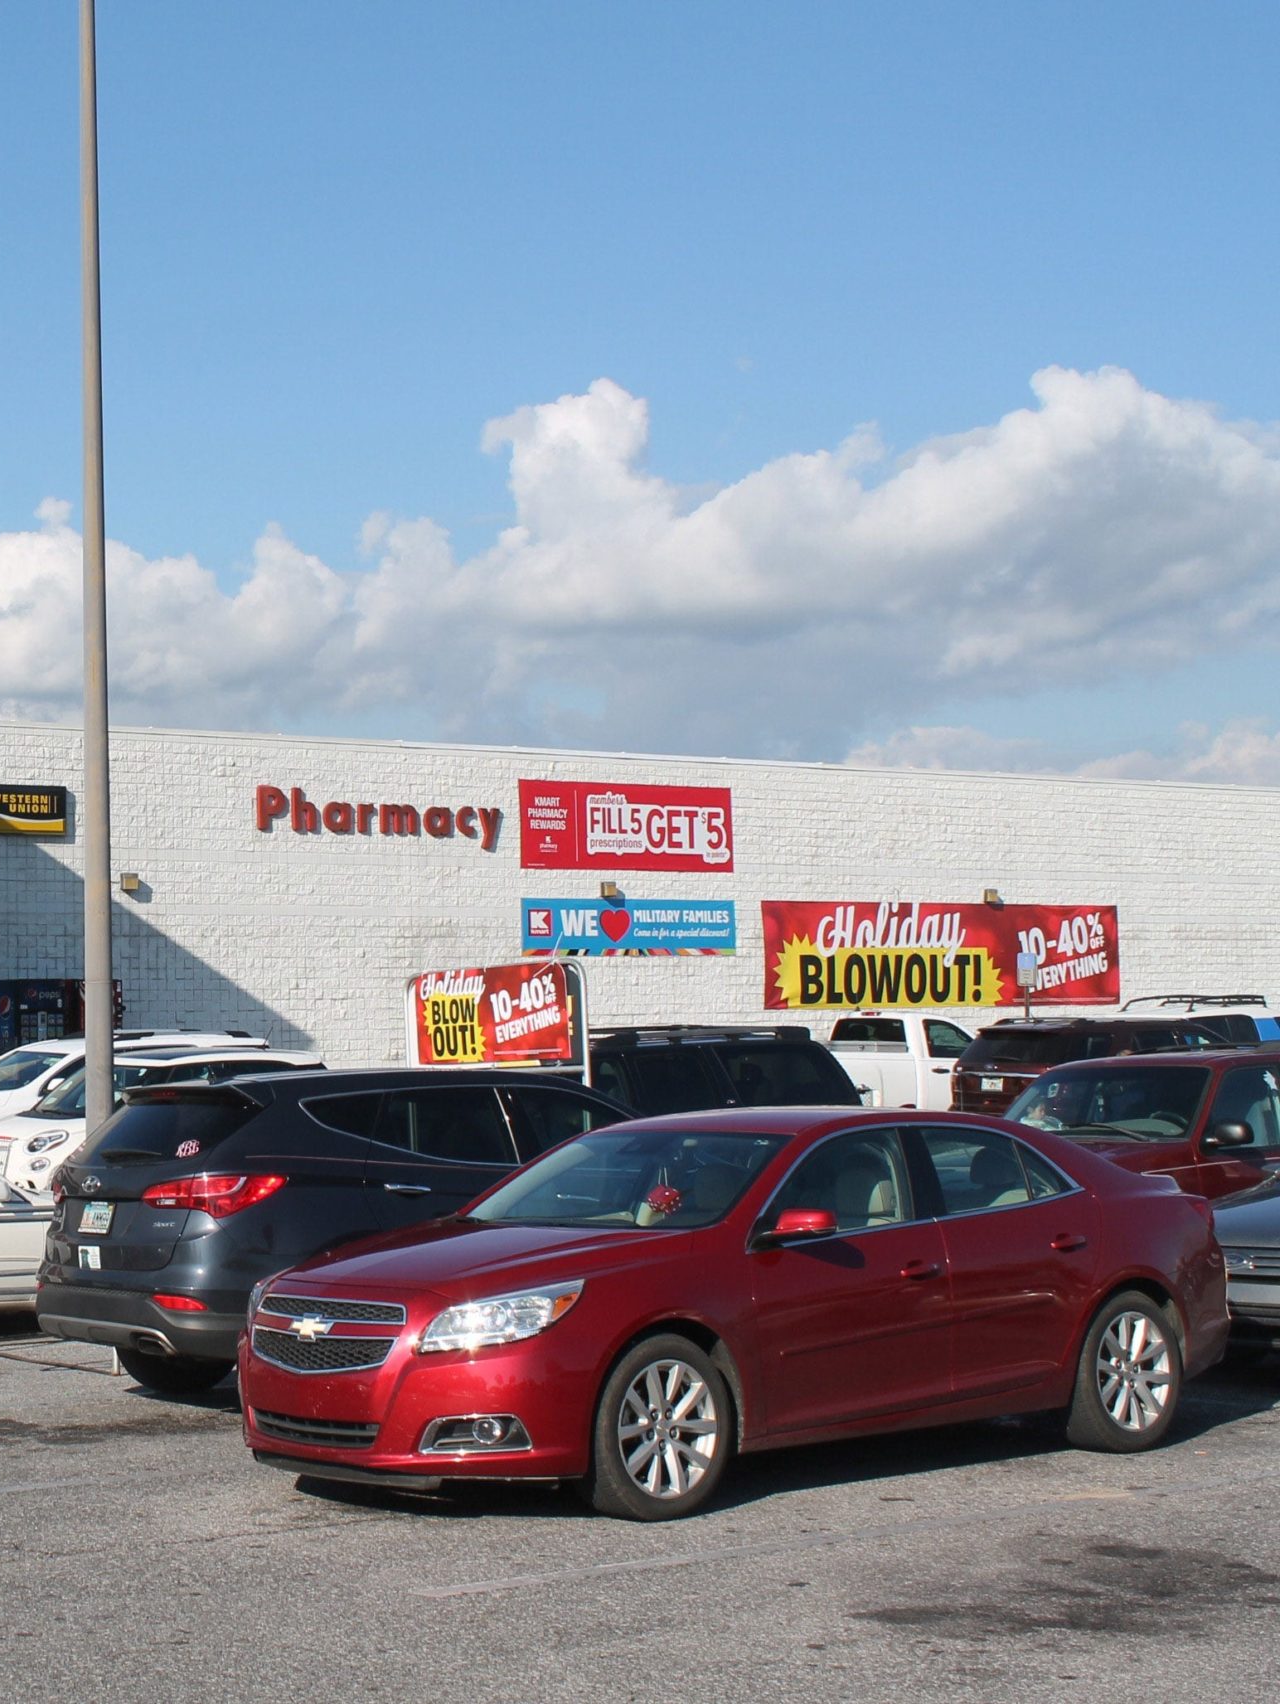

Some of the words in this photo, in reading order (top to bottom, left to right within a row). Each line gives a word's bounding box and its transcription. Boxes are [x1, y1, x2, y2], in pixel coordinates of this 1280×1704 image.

[9, 803, 48, 813] UNION
[527, 807, 568, 819] PHARMACY
[534, 796, 560, 807] KMART
[256, 784, 501, 850] Pharmacy
[530, 819, 566, 830] REWARDS
[590, 807, 628, 834] FILL
[630, 808, 643, 835] 5
[646, 808, 699, 849] GET
[590, 837, 643, 849] prescriptions
[560, 909, 599, 937] WE
[633, 909, 680, 923] MILITARY
[682, 910, 730, 924] FAMILIES
[633, 928, 651, 937] Come
[658, 928, 670, 940] for
[677, 928, 700, 939] special
[815, 901, 967, 968] Holiday
[1090, 936, 1105, 950] OFF
[799, 953, 983, 1005] BLOWOUT!
[1029, 951, 1109, 993] VERYTHING
[420, 969, 486, 1005] Holiday
[545, 993, 557, 1005] OFF
[432, 997, 477, 1026] BLOW
[495, 1006, 561, 1044] EVERYTHING
[433, 1021, 477, 1056] OUT!
